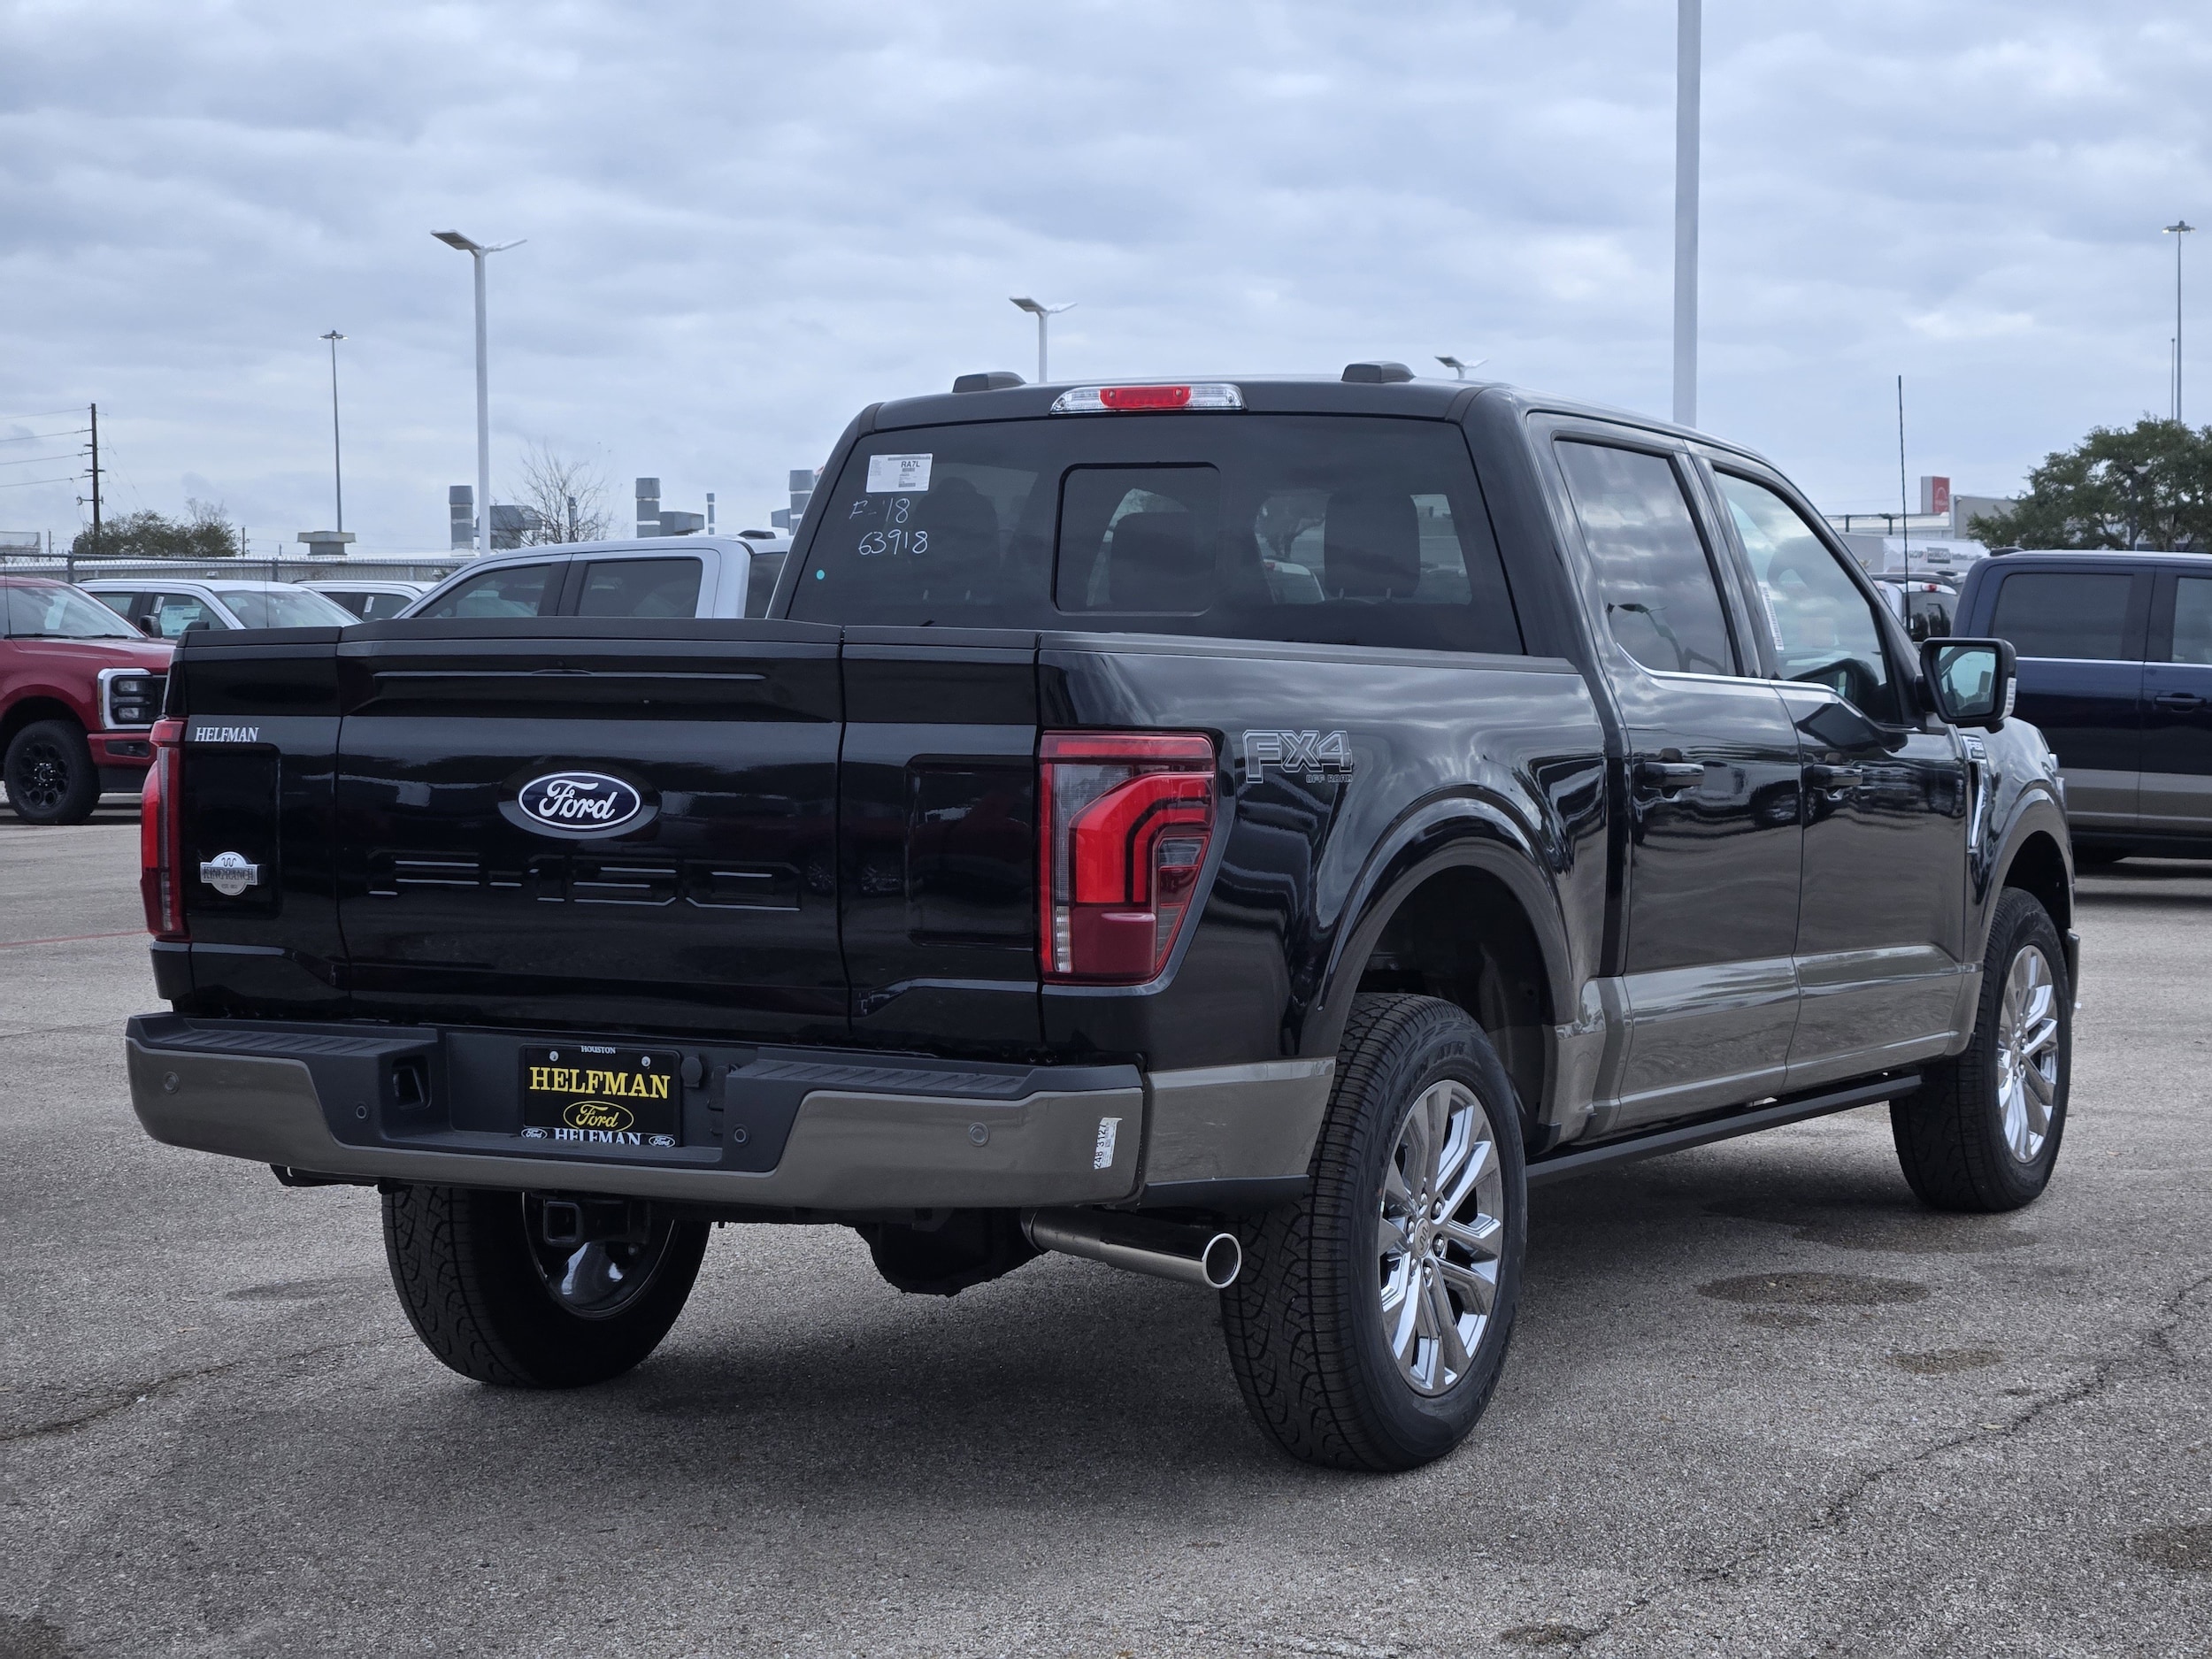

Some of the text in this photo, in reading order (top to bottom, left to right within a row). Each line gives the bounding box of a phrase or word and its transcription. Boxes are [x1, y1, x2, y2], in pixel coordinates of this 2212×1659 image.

[857, 528, 928, 555] 63918
[195, 726, 259, 743] HELFMAN
[1242, 729, 1353, 784] FX4
[1305, 774, 1325, 783] OFF
[538, 779, 618, 820] Ford
[580, 1045, 616, 1054] HOUSTON
[529, 1066, 671, 1099] HELFMAN
[575, 1103, 619, 1128] Ford
